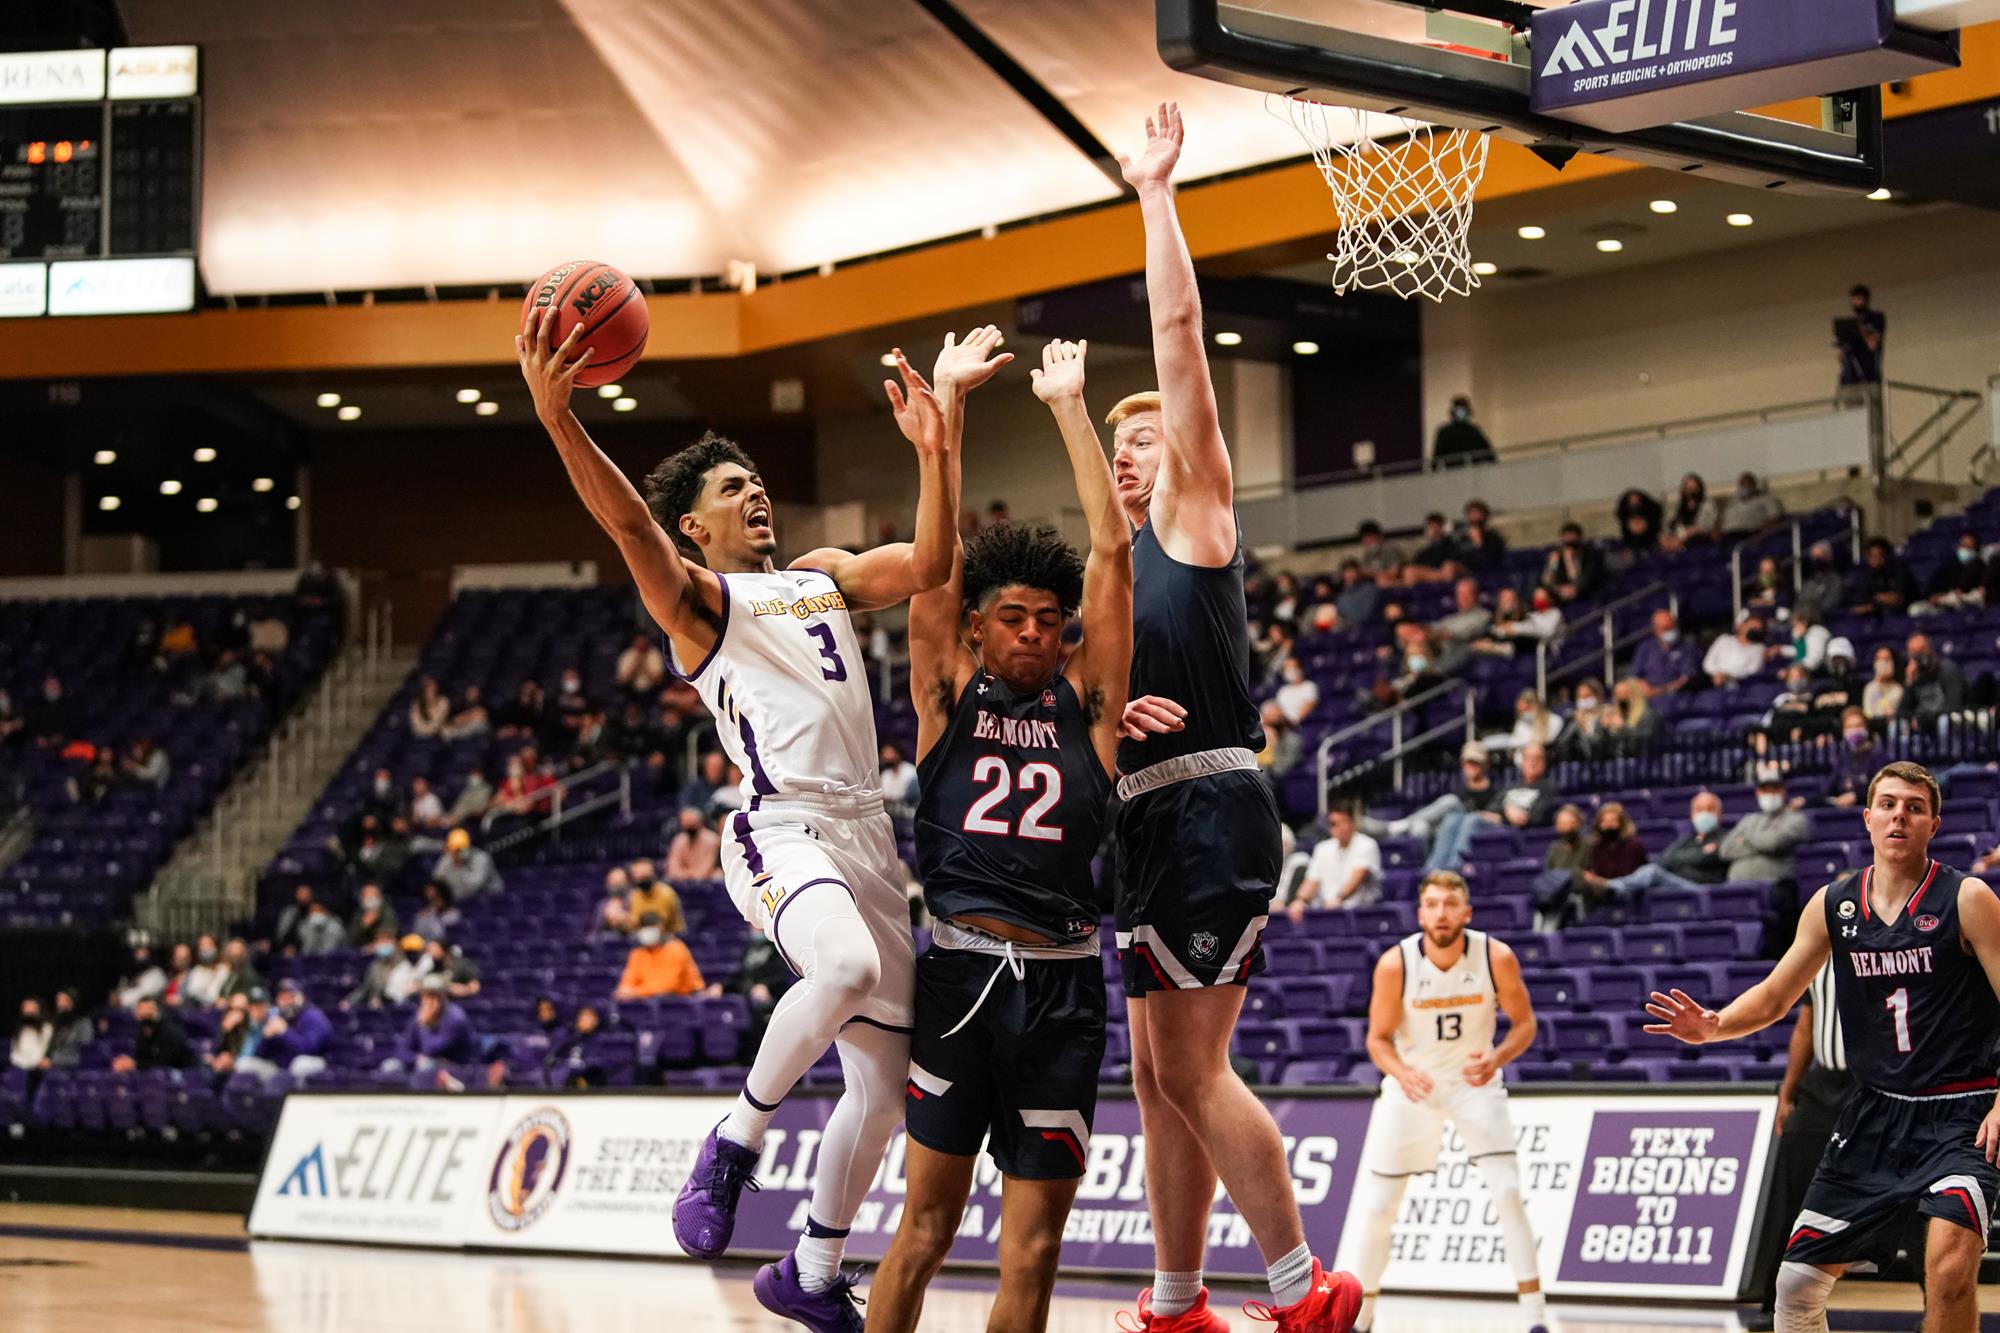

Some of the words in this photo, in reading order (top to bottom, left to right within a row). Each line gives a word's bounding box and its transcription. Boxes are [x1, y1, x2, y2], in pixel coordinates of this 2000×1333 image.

[1593, 0, 1737, 64] ELITE
[4, 63, 86, 88] RENA
[1573, 74, 1609, 93] SPORTS
[1610, 66, 1657, 87] MEDICINE
[1667, 51, 1734, 77] ORTHOPEDICS
[572, 271, 620, 317] NCAA
[805, 622, 847, 682] 3
[963, 754, 1064, 842] 22
[1850, 946, 1933, 977] BELMONT
[1436, 1013, 1462, 1041] 13
[1885, 987, 1912, 1052] 1
[597, 1137, 706, 1163] SUPPOR
[1629, 1127, 1715, 1157] TEXT
[334, 1126, 479, 1203] ELITE
[1587, 1156, 1740, 1195] BISONS
[1396, 1198, 1471, 1226] NFO
[1635, 1196, 1677, 1225] TO
[1388, 1233, 1430, 1262] HE
[1440, 1233, 1542, 1264] HER
[1579, 1224, 1714, 1265] 888111
